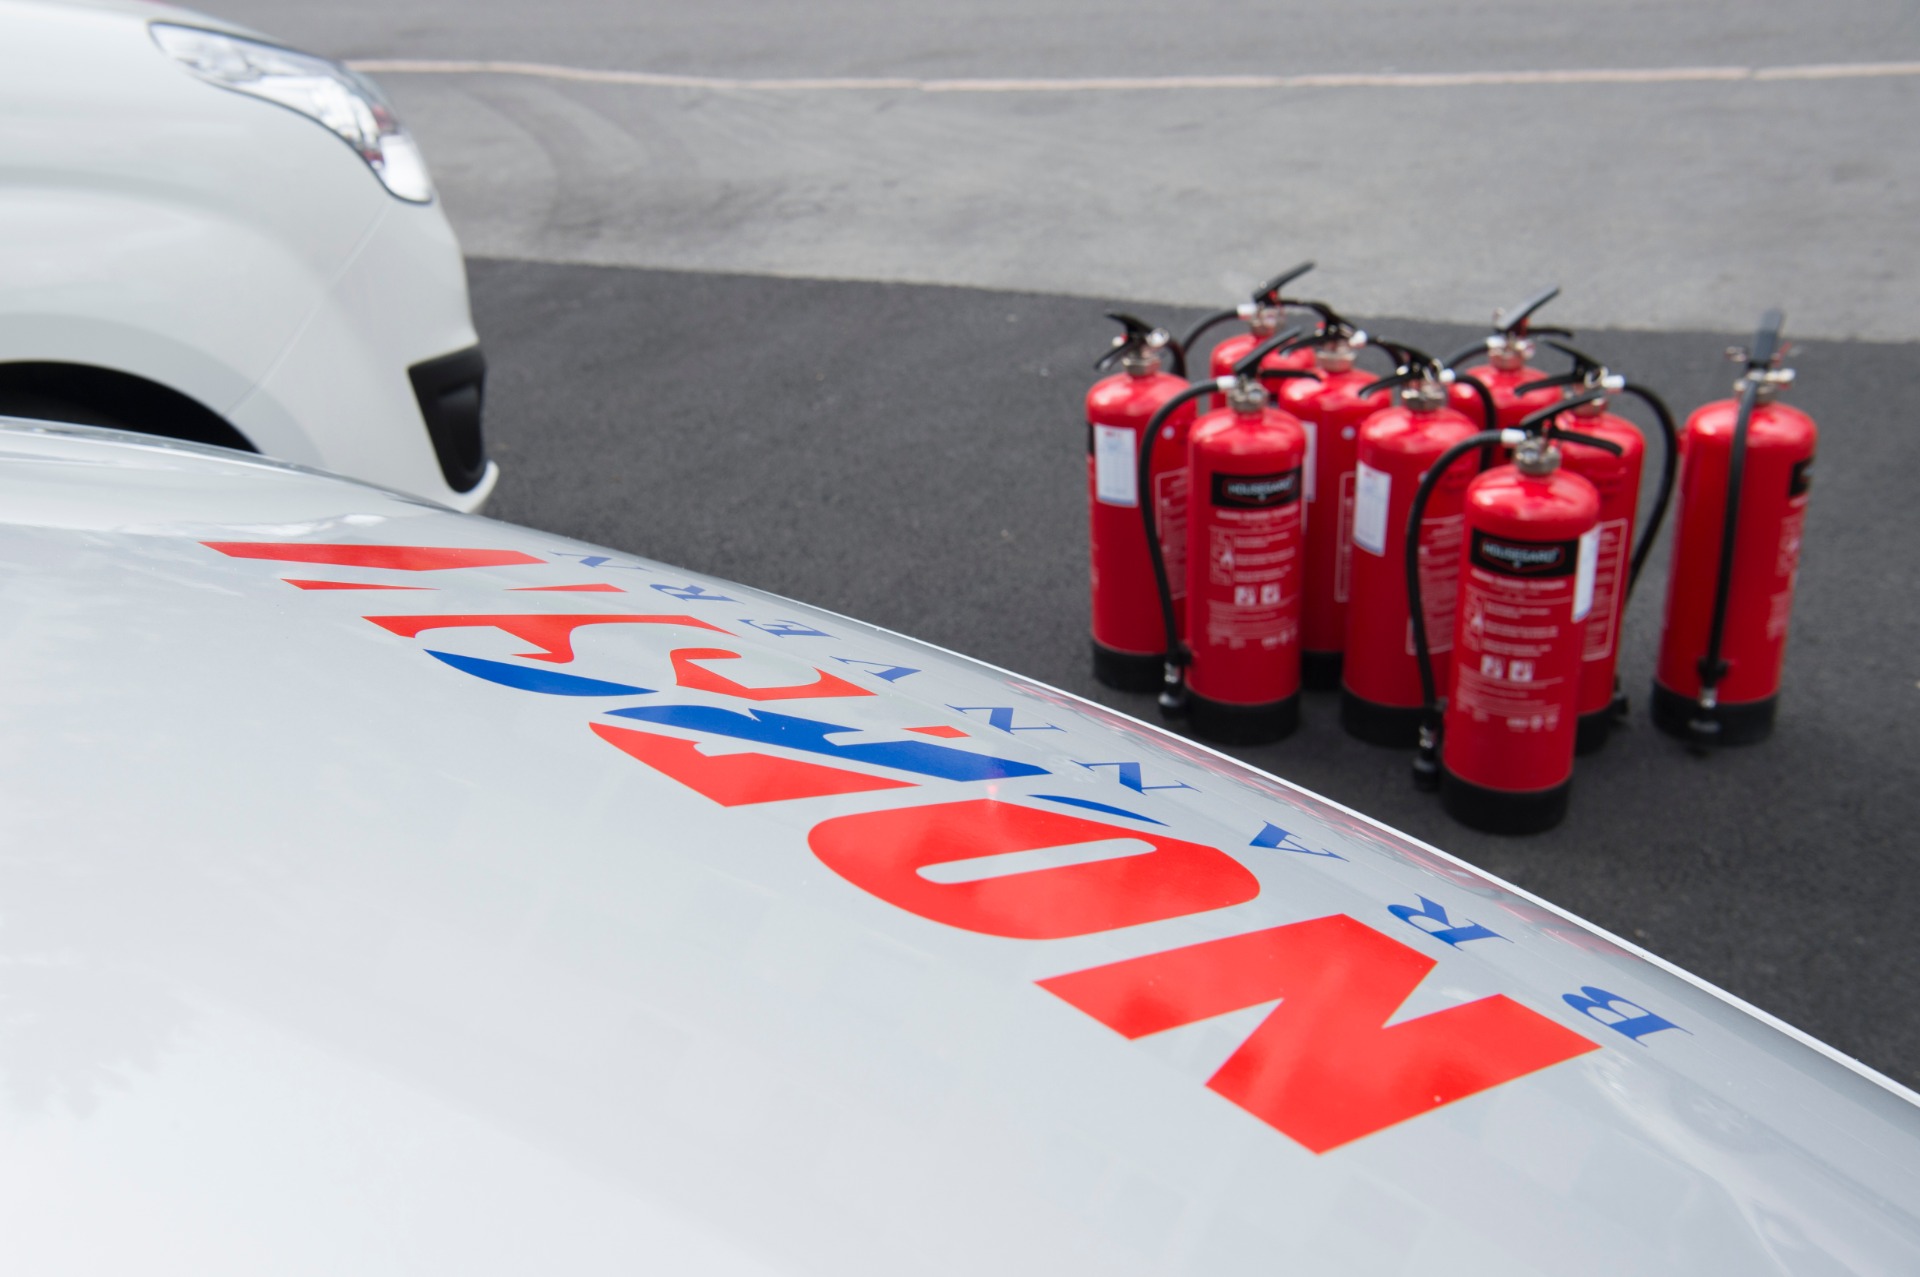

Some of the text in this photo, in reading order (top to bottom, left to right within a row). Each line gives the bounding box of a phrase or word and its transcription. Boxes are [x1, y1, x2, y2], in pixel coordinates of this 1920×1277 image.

[548, 550, 1694, 1047] BRANNVERN
[1482, 541, 1557, 563] HOUSEGARD
[202, 541, 1601, 1155] NORSK
